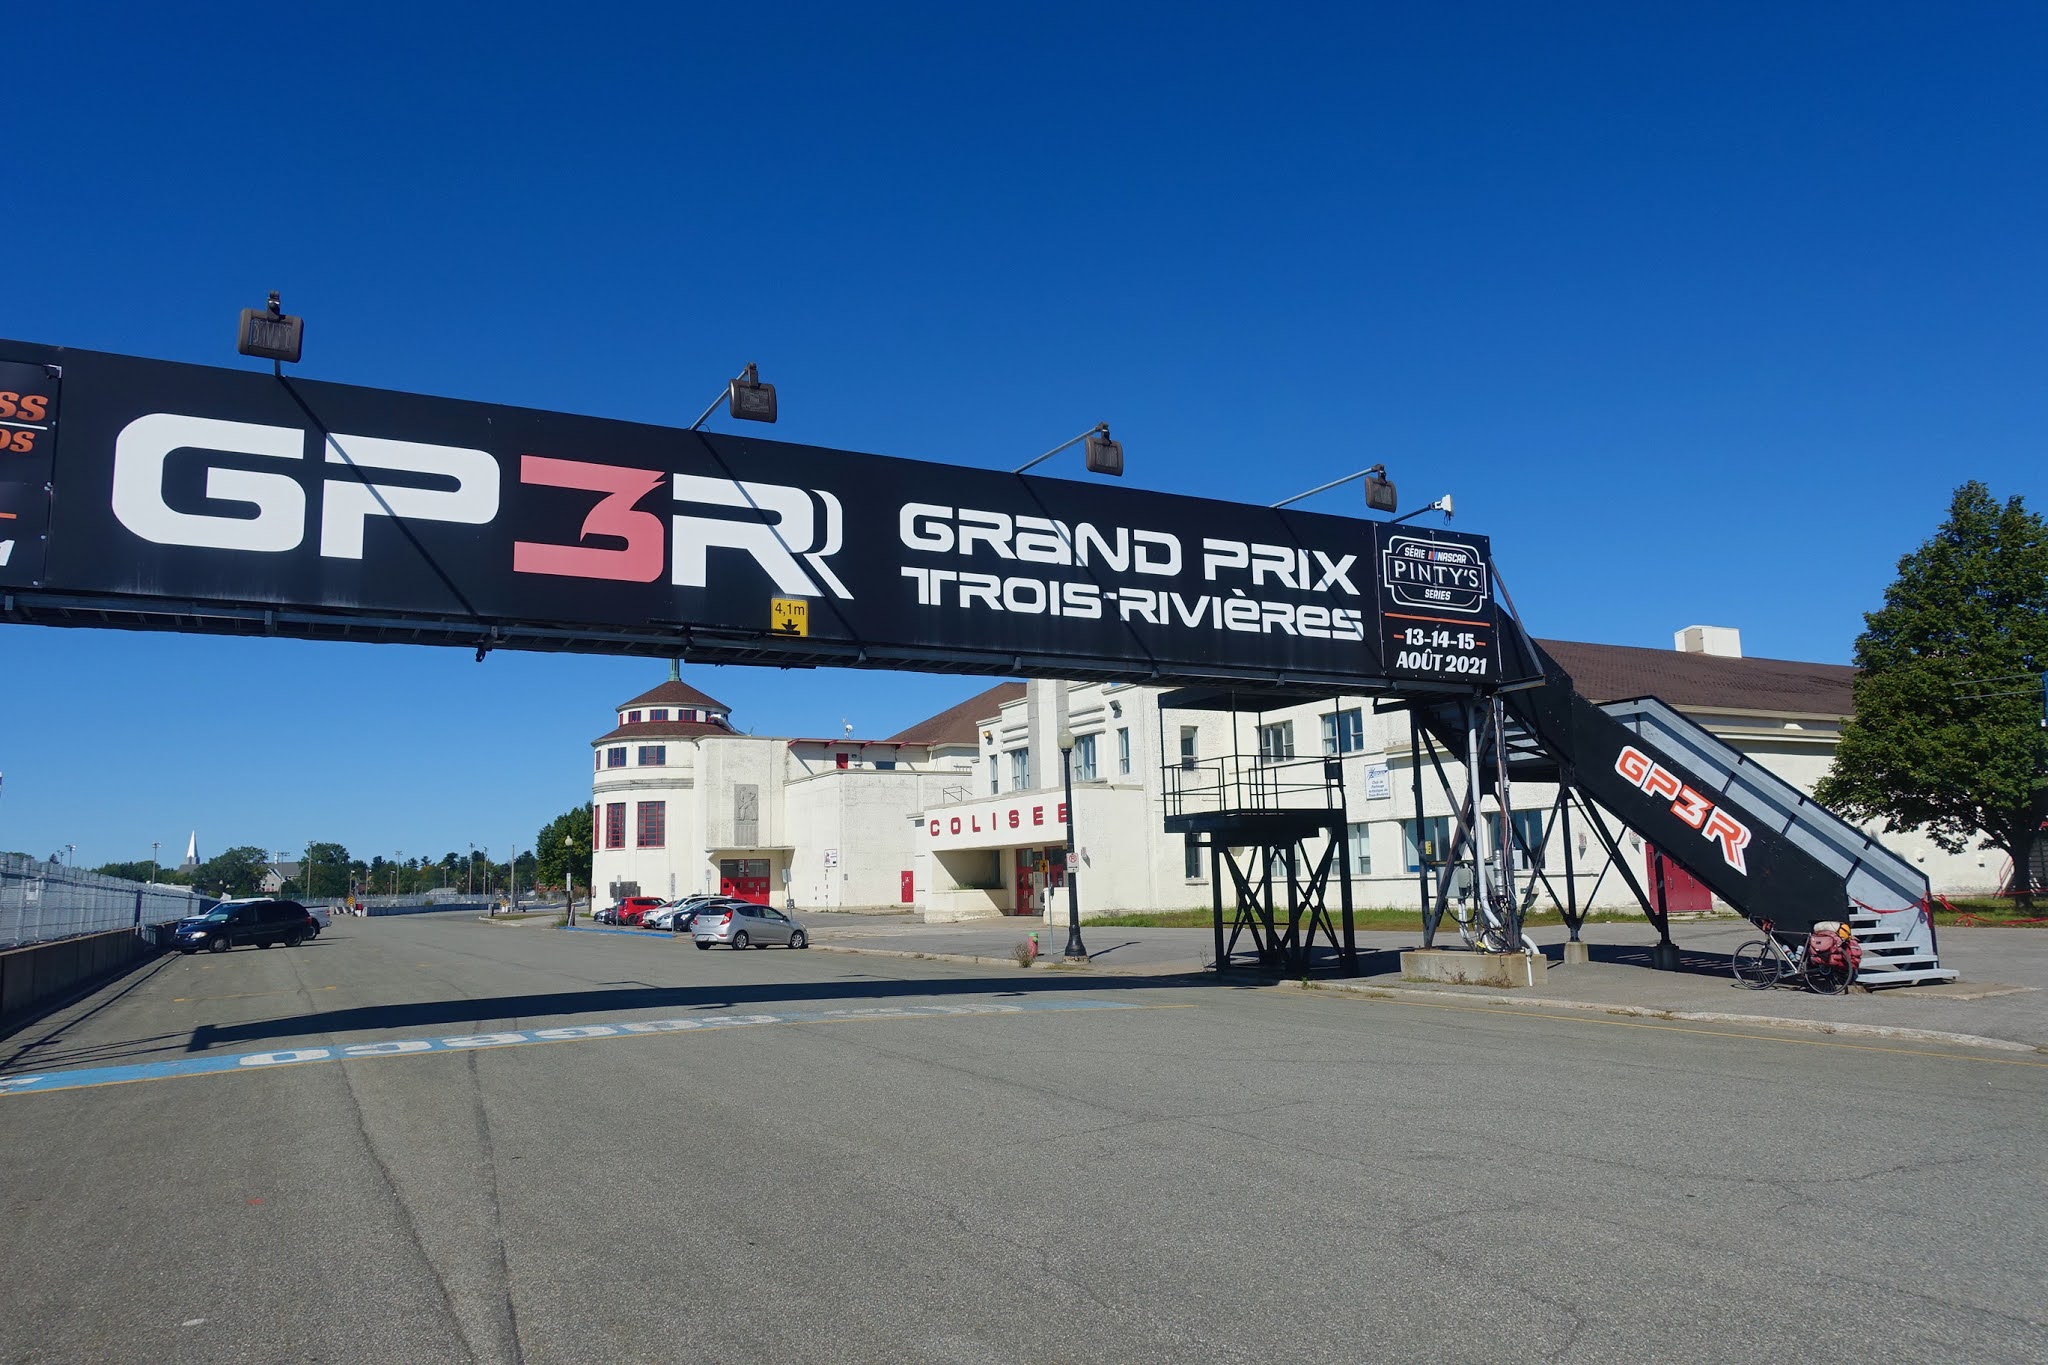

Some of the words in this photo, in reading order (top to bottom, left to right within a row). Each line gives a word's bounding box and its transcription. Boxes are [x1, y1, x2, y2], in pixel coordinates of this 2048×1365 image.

[111, 412, 855, 600] GP3R
[1203, 537, 1361, 596] PRIX
[1404, 545, 1426, 559] SÉRIE
[1436, 551, 1467, 564] NASCAR
[1394, 560, 1479, 588] PINTY'S
[1424, 588, 1452, 601] SERIES
[775, 602, 805, 616] 4,1m
[1396, 648, 1444, 672] AOÛT
[1444, 654, 1487, 675] 2021
[930, 803, 1067, 836] COLISEE
[1614, 745, 1752, 877] GP3R
